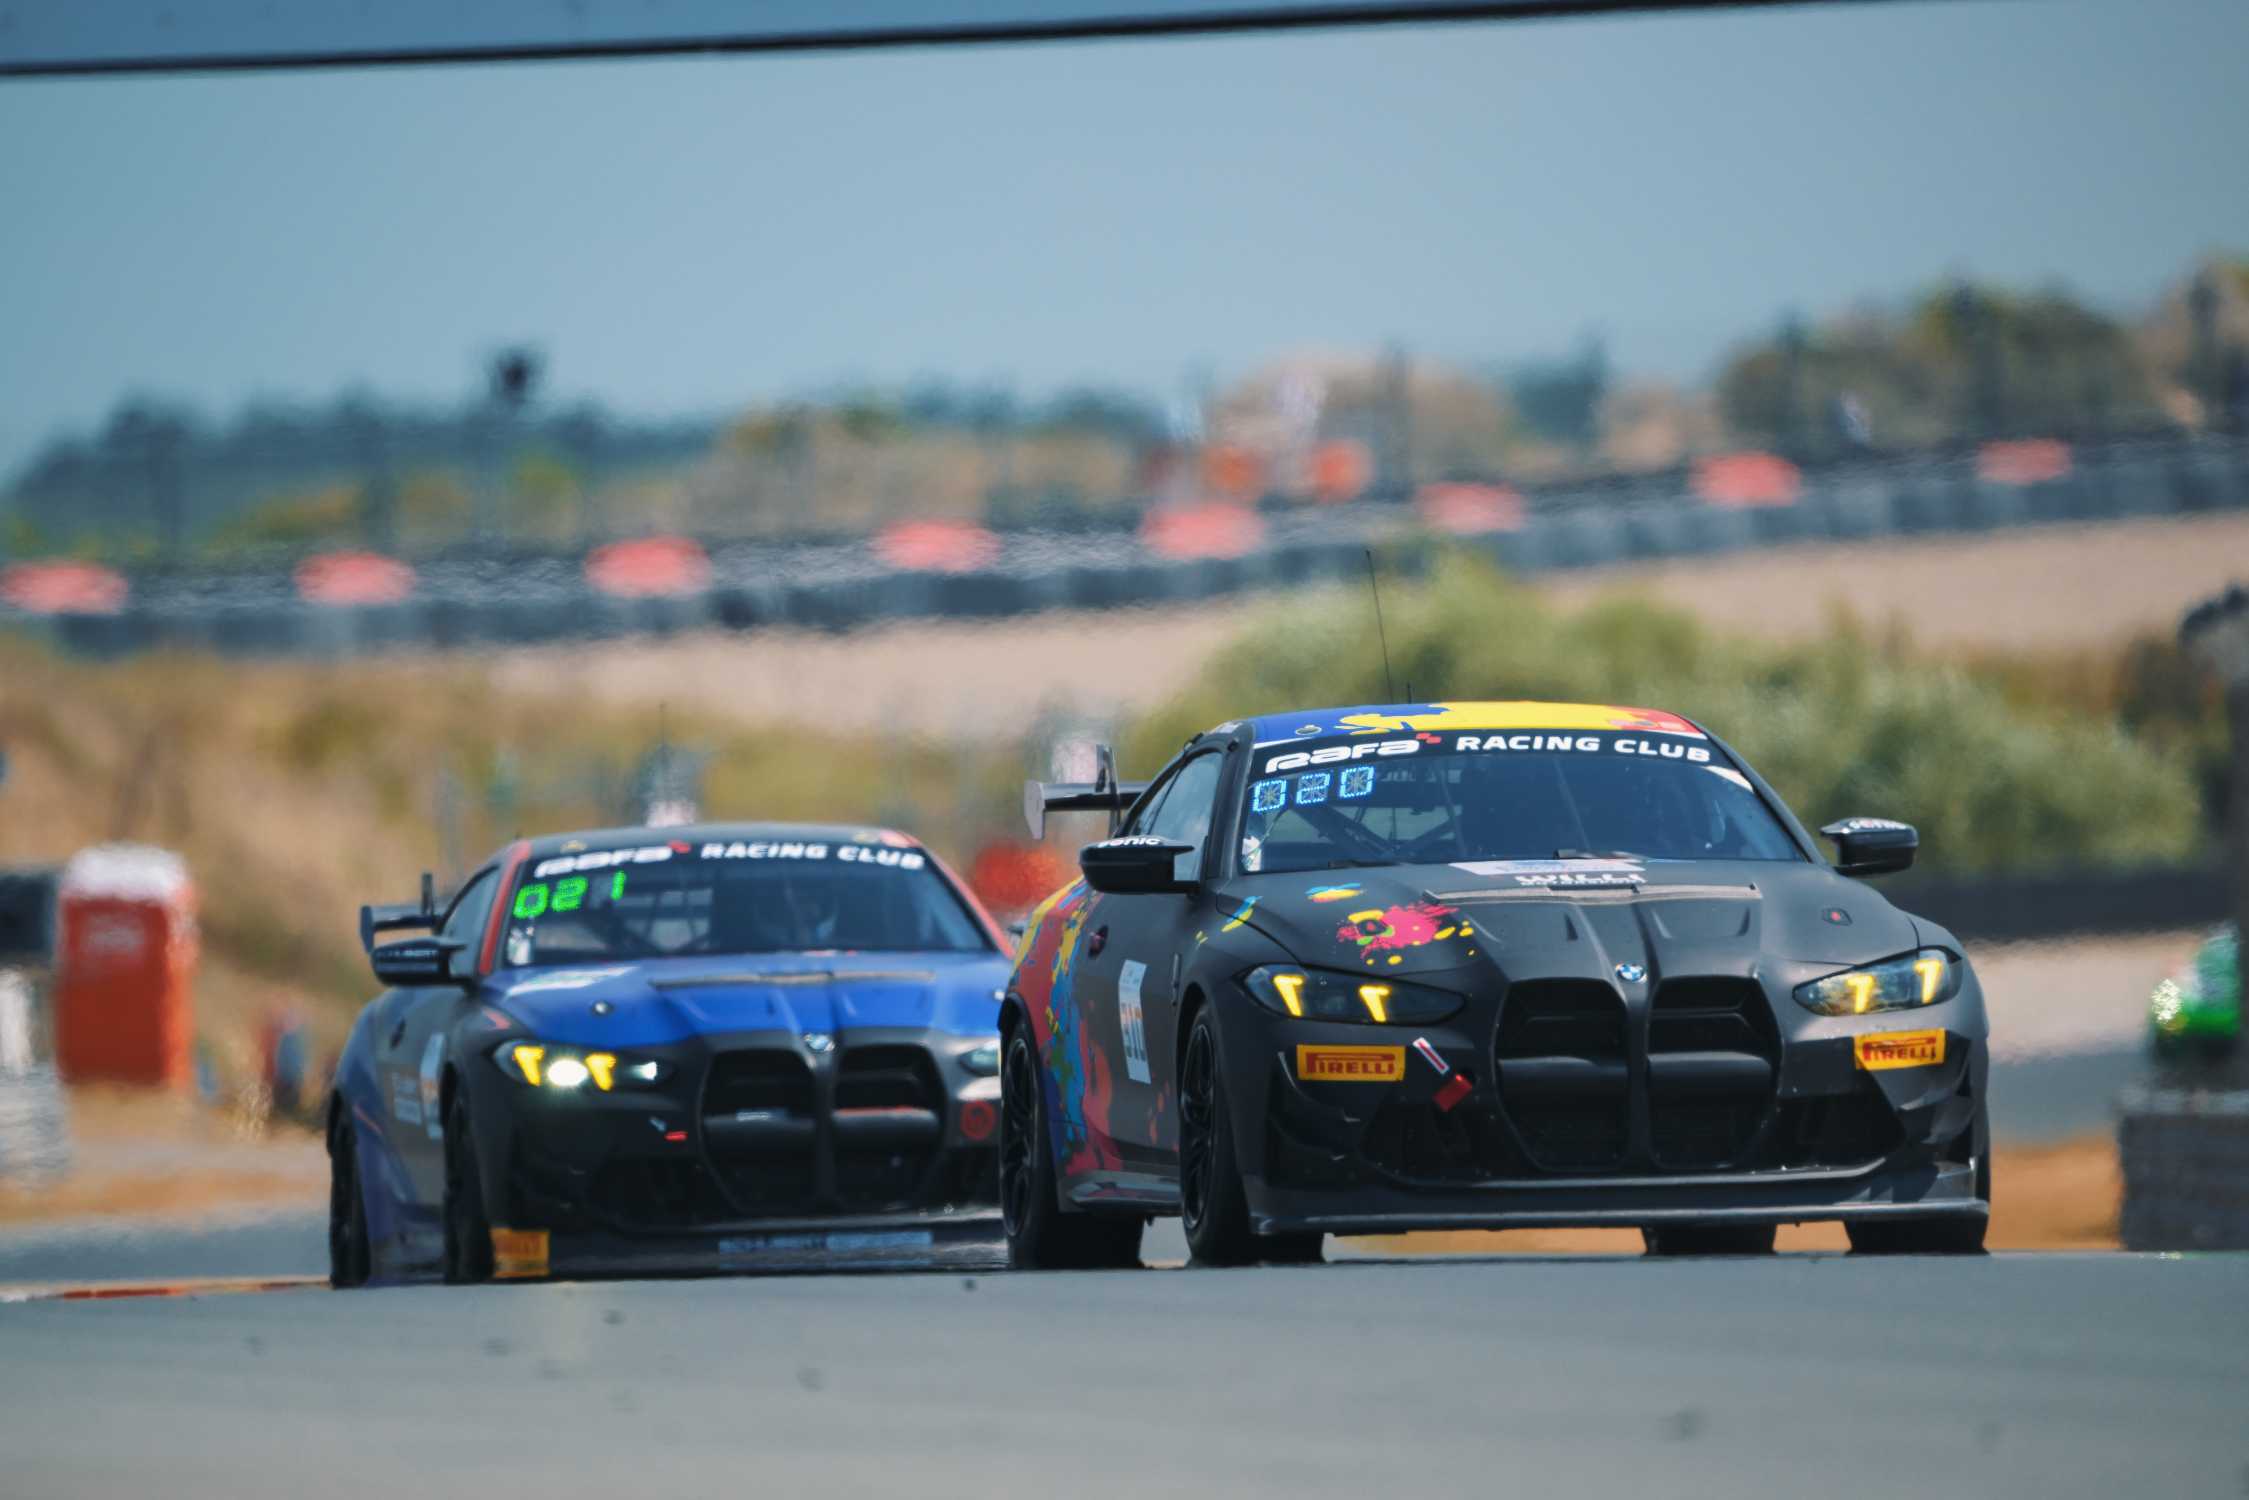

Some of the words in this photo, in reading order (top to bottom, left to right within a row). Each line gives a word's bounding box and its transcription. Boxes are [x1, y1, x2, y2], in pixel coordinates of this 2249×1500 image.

[1455, 735, 1602, 752] RACING
[1613, 739, 1711, 763] CLUB
[1252, 765, 1375, 812] 020
[700, 841, 828, 860] RACING
[836, 844, 925, 870] CLUB
[512, 869, 627, 919] 021
[1862, 1036, 1937, 1062] PIRELLI
[1305, 1052, 1396, 1075] PIRELLI
